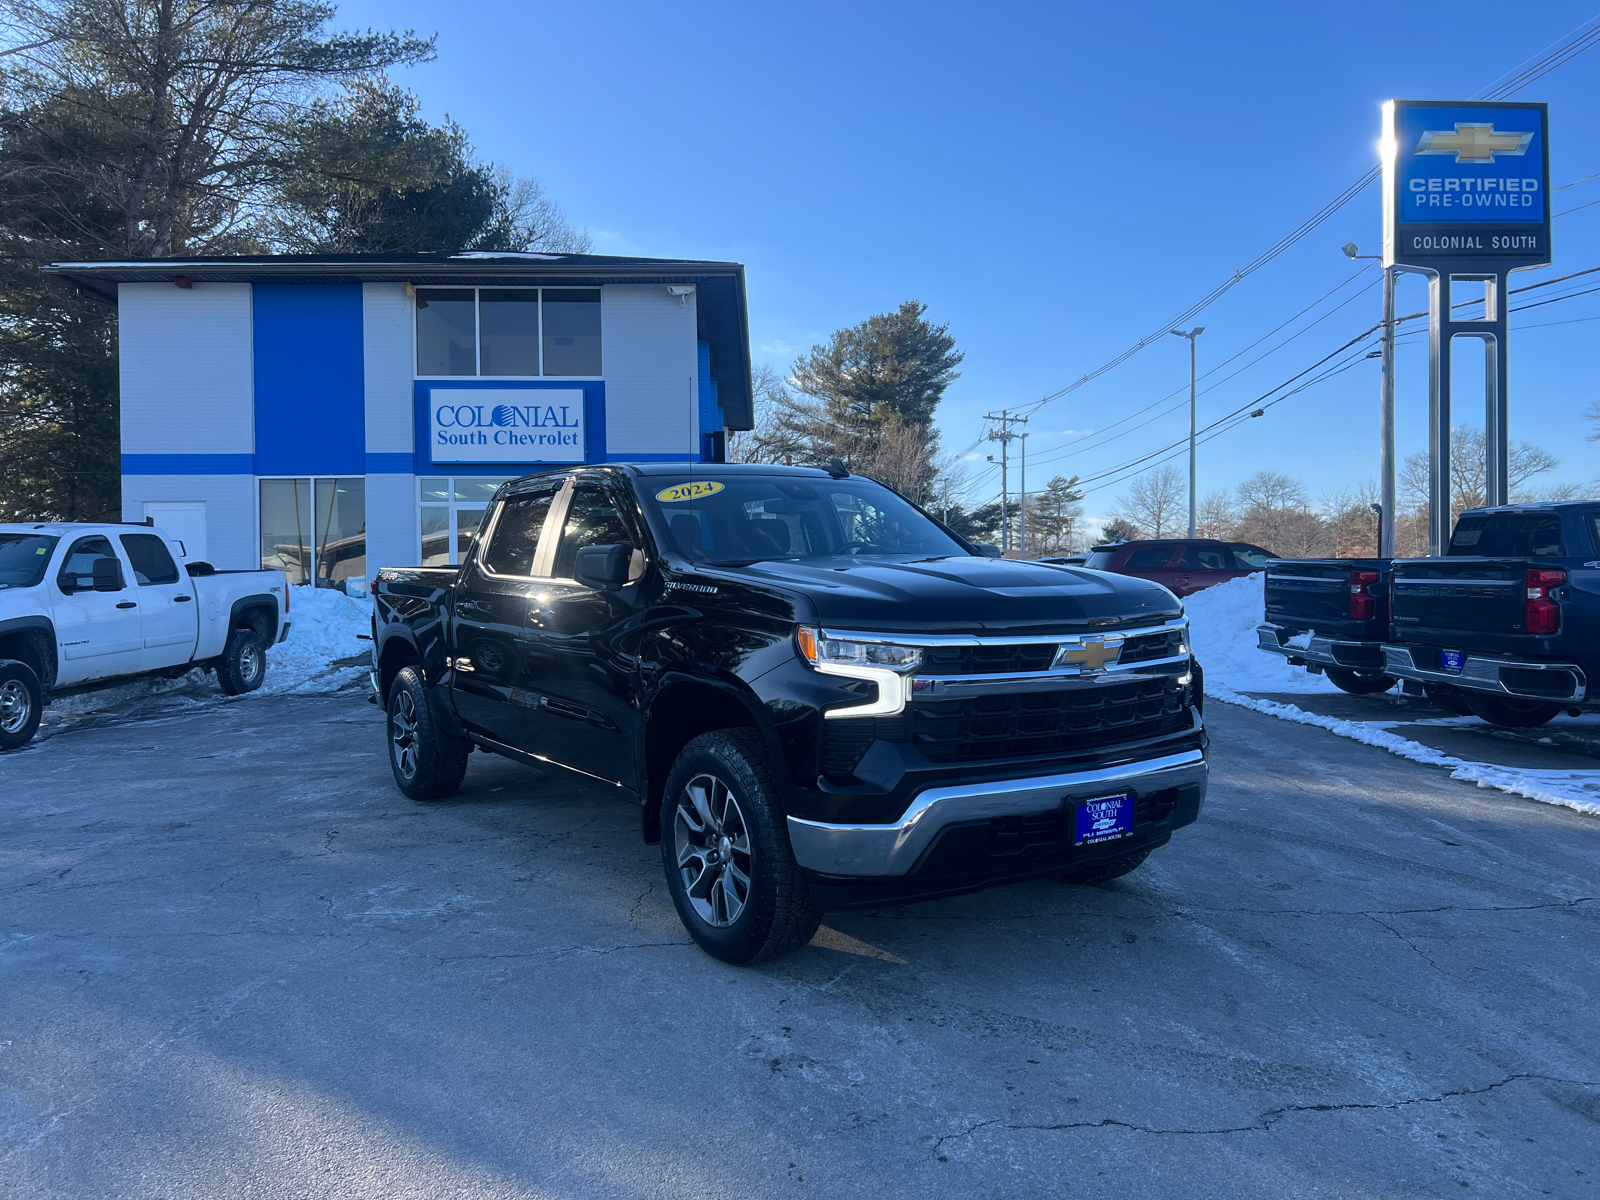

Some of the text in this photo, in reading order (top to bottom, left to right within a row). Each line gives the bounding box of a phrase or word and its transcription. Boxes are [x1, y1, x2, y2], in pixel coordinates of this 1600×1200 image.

[1409, 178, 1538, 192] CERTIFIED
[1416, 194, 1532, 207] PRE-OWNED
[1413, 236, 1536, 249] COLONIAL SOUTH
[436, 404, 579, 428] COLONIAL
[437, 430, 578, 445] South Chevrolet
[669, 482, 713, 500] 2024
[1086, 800, 1123, 813] COLONIAL
[1091, 809, 1117, 820] SOUTH
[1107, 833, 1122, 841] SOUTH
